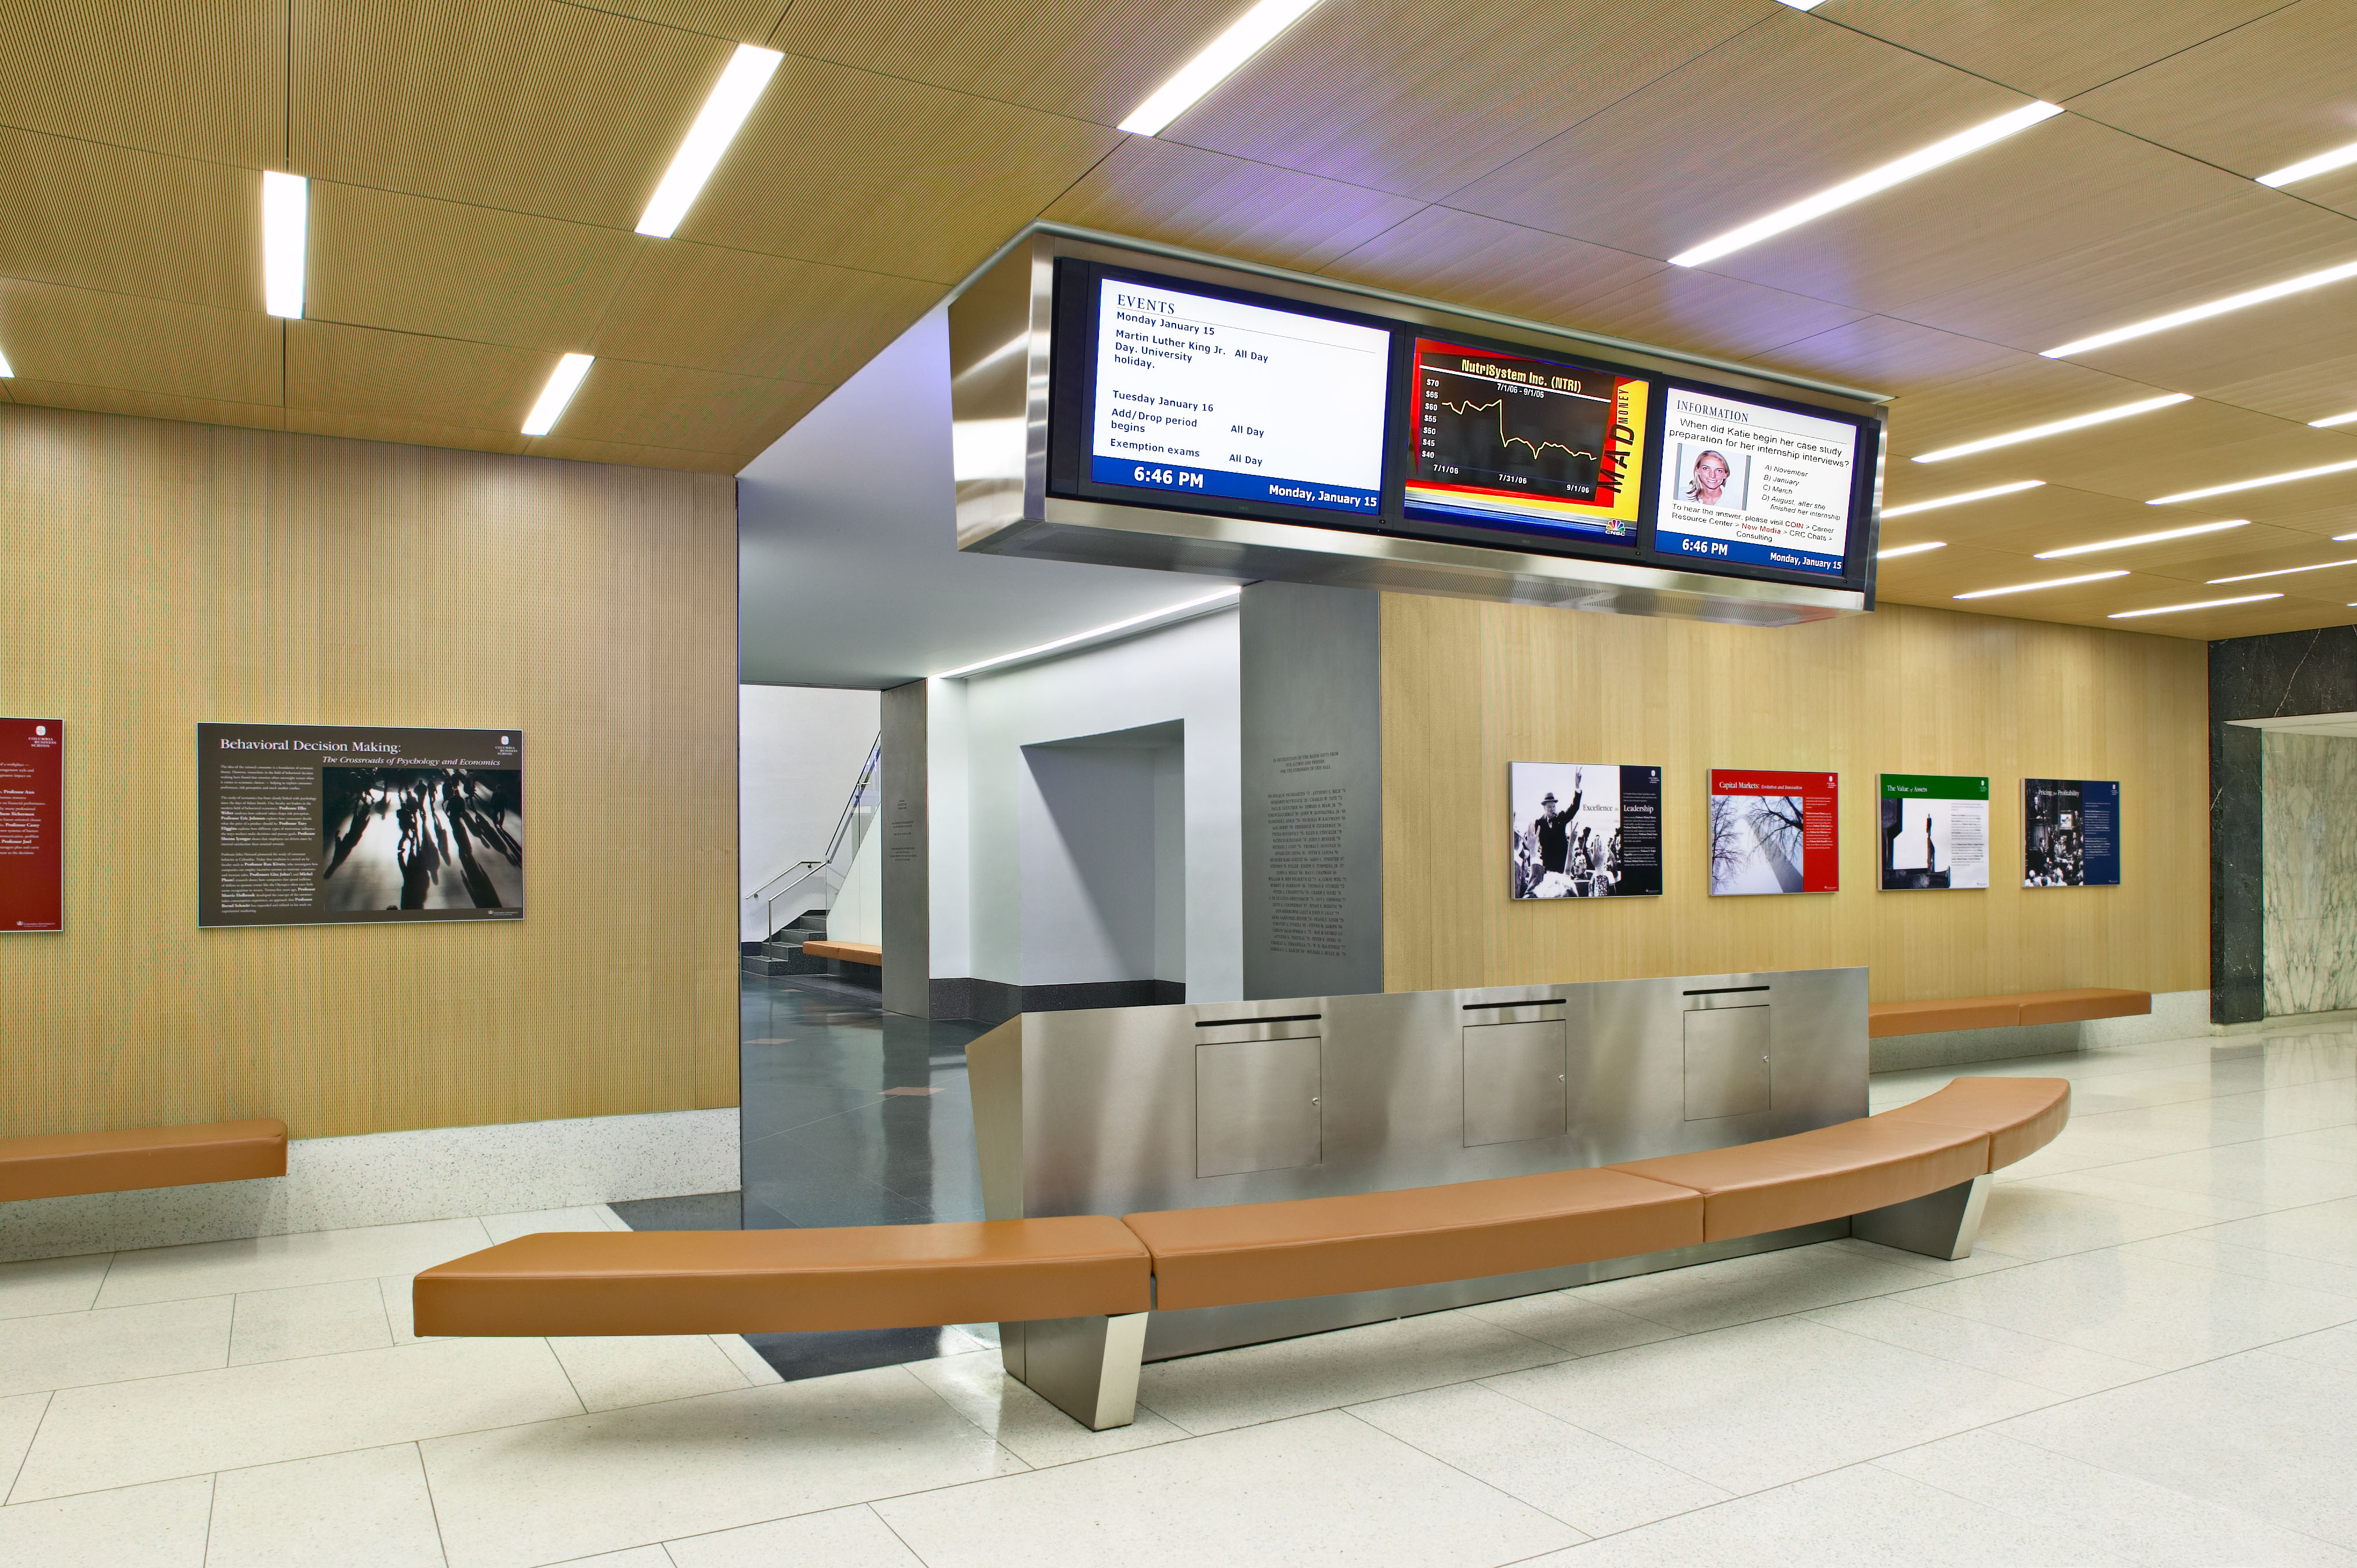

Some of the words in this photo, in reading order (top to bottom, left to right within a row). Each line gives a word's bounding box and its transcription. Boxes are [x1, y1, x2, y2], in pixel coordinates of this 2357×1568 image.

[1118, 294, 1174, 314] EVENTS
[1117, 311, 1156, 327] Monday
[1159, 318, 1199, 334] January
[1203, 326, 1214, 335] 15
[1116, 329, 1148, 342] Martin
[1152, 335, 1185, 347] Luther
[1189, 341, 1210, 354] King
[1213, 346, 1225, 354] Jr.
[1115, 342, 1137, 354] Day.
[1141, 346, 1192, 363] University
[1235, 349, 1246, 358] All
[1250, 352, 1268, 363] Day
[1115, 354, 1154, 369] holiday.
[1426, 378, 1439, 387] $70
[1462, 359, 1526, 382] NutriSystem
[1529, 372, 1547, 386] Inc.
[1551, 376, 1581, 393] (NTRI)
[1426, 390, 1438, 398] $65
[1497, 383, 1517, 393] 7/1/06
[1523, 388, 1544, 398] 9/1/06
[1112, 390, 1155, 405] Tuesday
[1158, 397, 1198, 411] January
[1202, 404, 1213, 412] 16
[1424, 402, 1437, 411] $60
[1111, 408, 1162, 424] Add/Drop
[1166, 417, 1196, 427] period
[1424, 414, 1437, 422] $55
[1677, 400, 1748, 422] INFORMATION
[1111, 420, 1145, 432] begins
[1231, 425, 1242, 433] All
[1247, 427, 1264, 438] Day
[1597, 424, 1635, 493] MAD
[1618, 389, 1629, 424] MONEY
[1680, 418, 1707, 430] When
[1710, 424, 1724, 433] did
[1727, 427, 1750, 438] Katie
[1753, 432, 1777, 444] begin
[1780, 437, 1794, 447] her
[1797, 442, 1816, 451] case
[1819, 447, 1841, 457] study
[1111, 438, 1163, 452] Exemption
[1167, 447, 1199, 457] exams
[1422, 450, 1434, 458] $40
[1669, 430, 1722, 444] preparation
[1725, 438, 1738, 447] for
[1740, 441, 1755, 450] her
[1757, 446, 1799, 460] internship
[1803, 452, 1849, 467] interviews?
[1229, 454, 1241, 462] All
[1245, 456, 1262, 467] Day
[1433, 464, 1458, 474] 7/1/06
[1774, 466, 1808, 477] November
[1134, 466, 1172, 484] 6:46
[1178, 471, 1203, 488] PM
[1499, 474, 1526, 484] 7/31/06
[1772, 477, 1799, 486] January
[1269, 484, 1315, 501] Monday,
[1318, 491, 1361, 507] January
[1364, 496, 1377, 506] 15
[1567, 484, 1589, 493] 9/1/06
[1770, 504, 1796, 513] finished
[1810, 511, 1840, 520] internship
[1672, 512, 1706, 522] Resource
[1709, 518, 1732, 527] Center
[1760, 525, 1781, 533] Media
[1807, 532, 1826, 540] Chats
[1812, 525, 1834, 533] Career
[1736, 531, 1772, 542] Consulting
[1682, 538, 1707, 553] 6:46
[1711, 542, 1728, 556] PM
[1770, 552, 1801, 565] Monday,
[1802, 557, 1831, 569] January
[1833, 561, 1841, 569] 15
[220, 739, 289, 750] Behavioral
[293, 741, 348, 751] Decision
[352, 742, 401, 753] Making:
[386, 757, 396, 765] of
[396, 757, 440, 766] Psychology
[1719, 781, 1737, 790] Capital
[1623, 804, 1653, 814] Leadership
